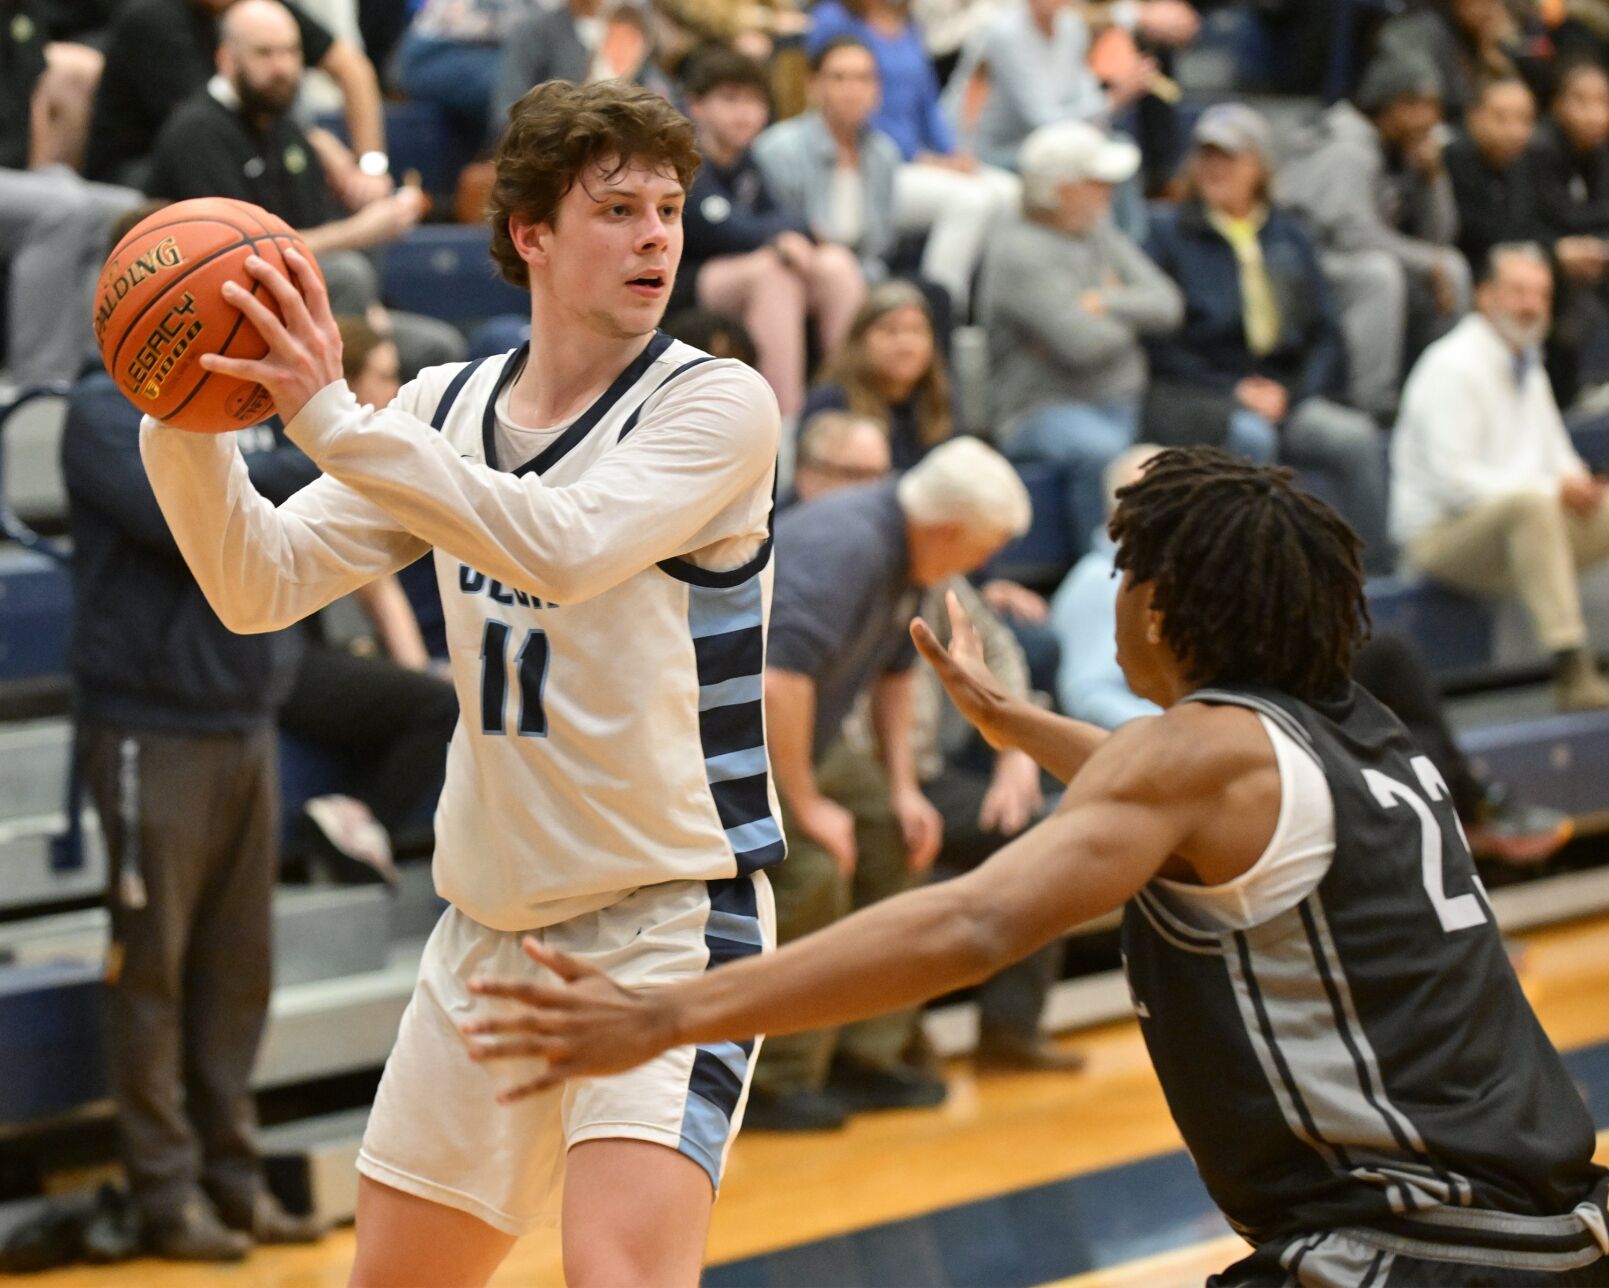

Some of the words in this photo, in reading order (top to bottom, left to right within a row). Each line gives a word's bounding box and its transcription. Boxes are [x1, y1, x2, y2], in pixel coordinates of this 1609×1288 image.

[122, 291, 196, 395] LEGACY
[153, 319, 204, 384] 1000
[479, 617, 549, 738] 11
